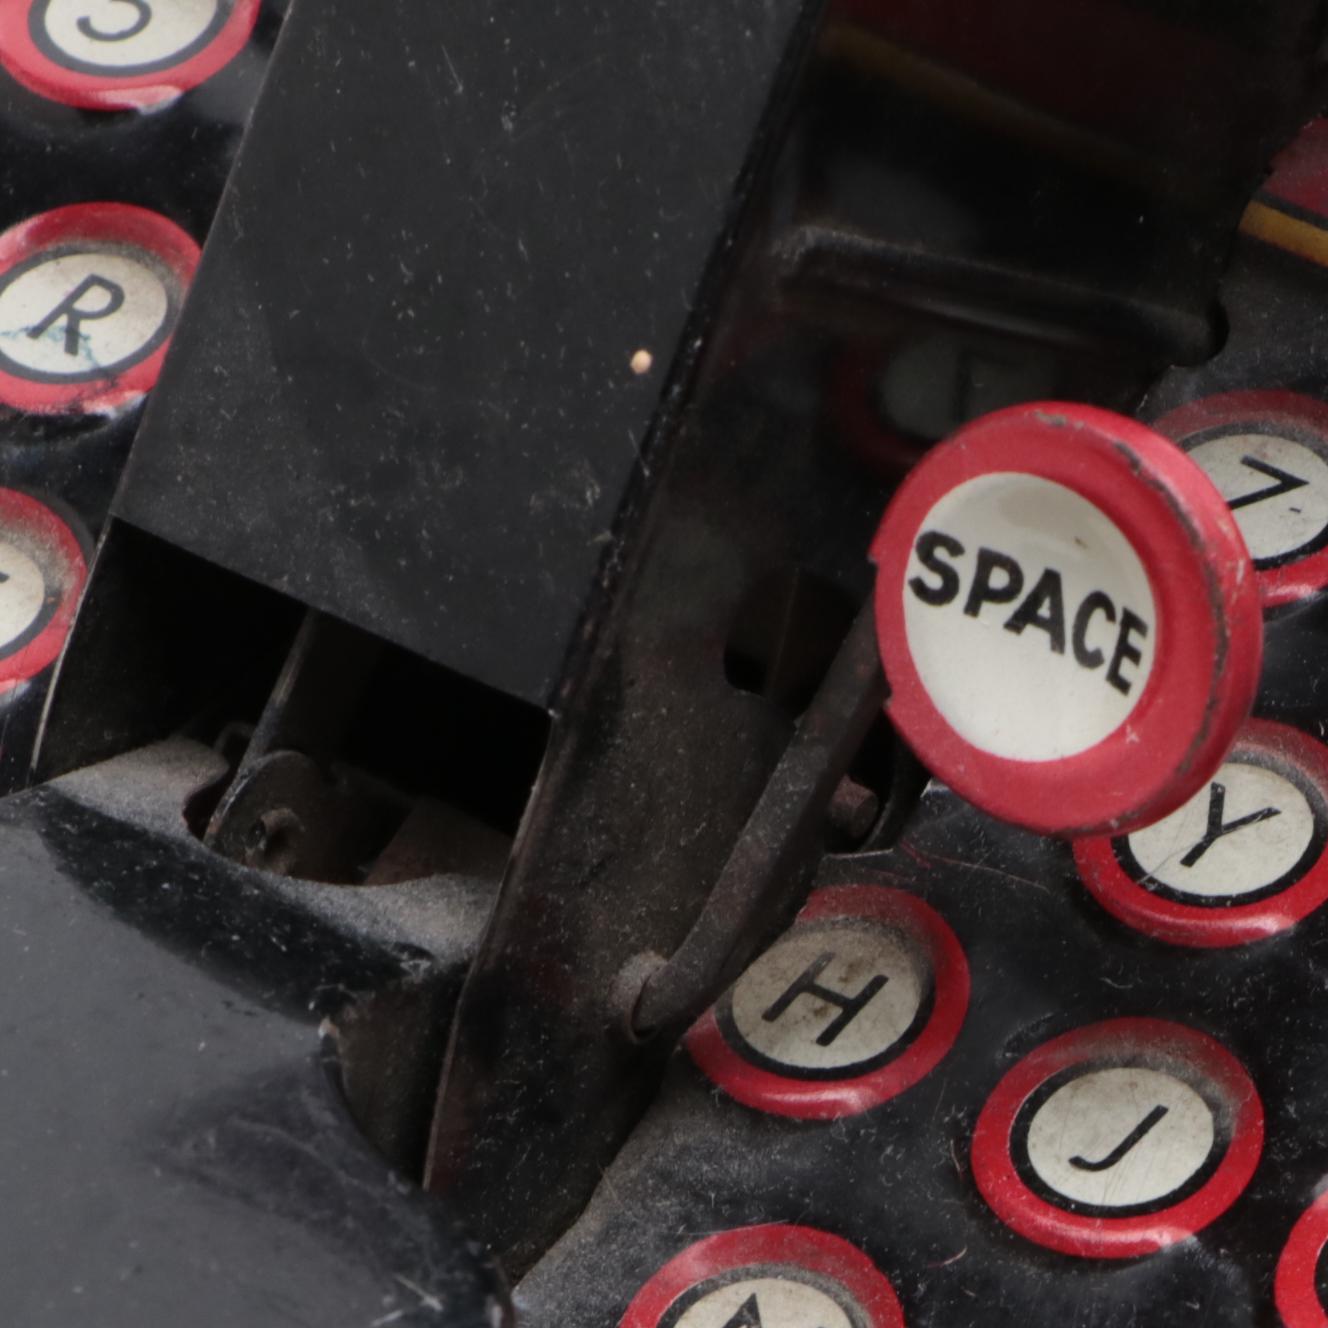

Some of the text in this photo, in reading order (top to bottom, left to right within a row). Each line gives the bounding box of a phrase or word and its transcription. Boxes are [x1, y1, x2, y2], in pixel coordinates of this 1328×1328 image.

[26, 273, 126, 356] R
[1224, 454, 1310, 511] 7
[908, 530, 1149, 696] SPACE
[1180, 781, 1281, 867] Y
[761, 952, 888, 1047] H
[1068, 1105, 1170, 1172] J
